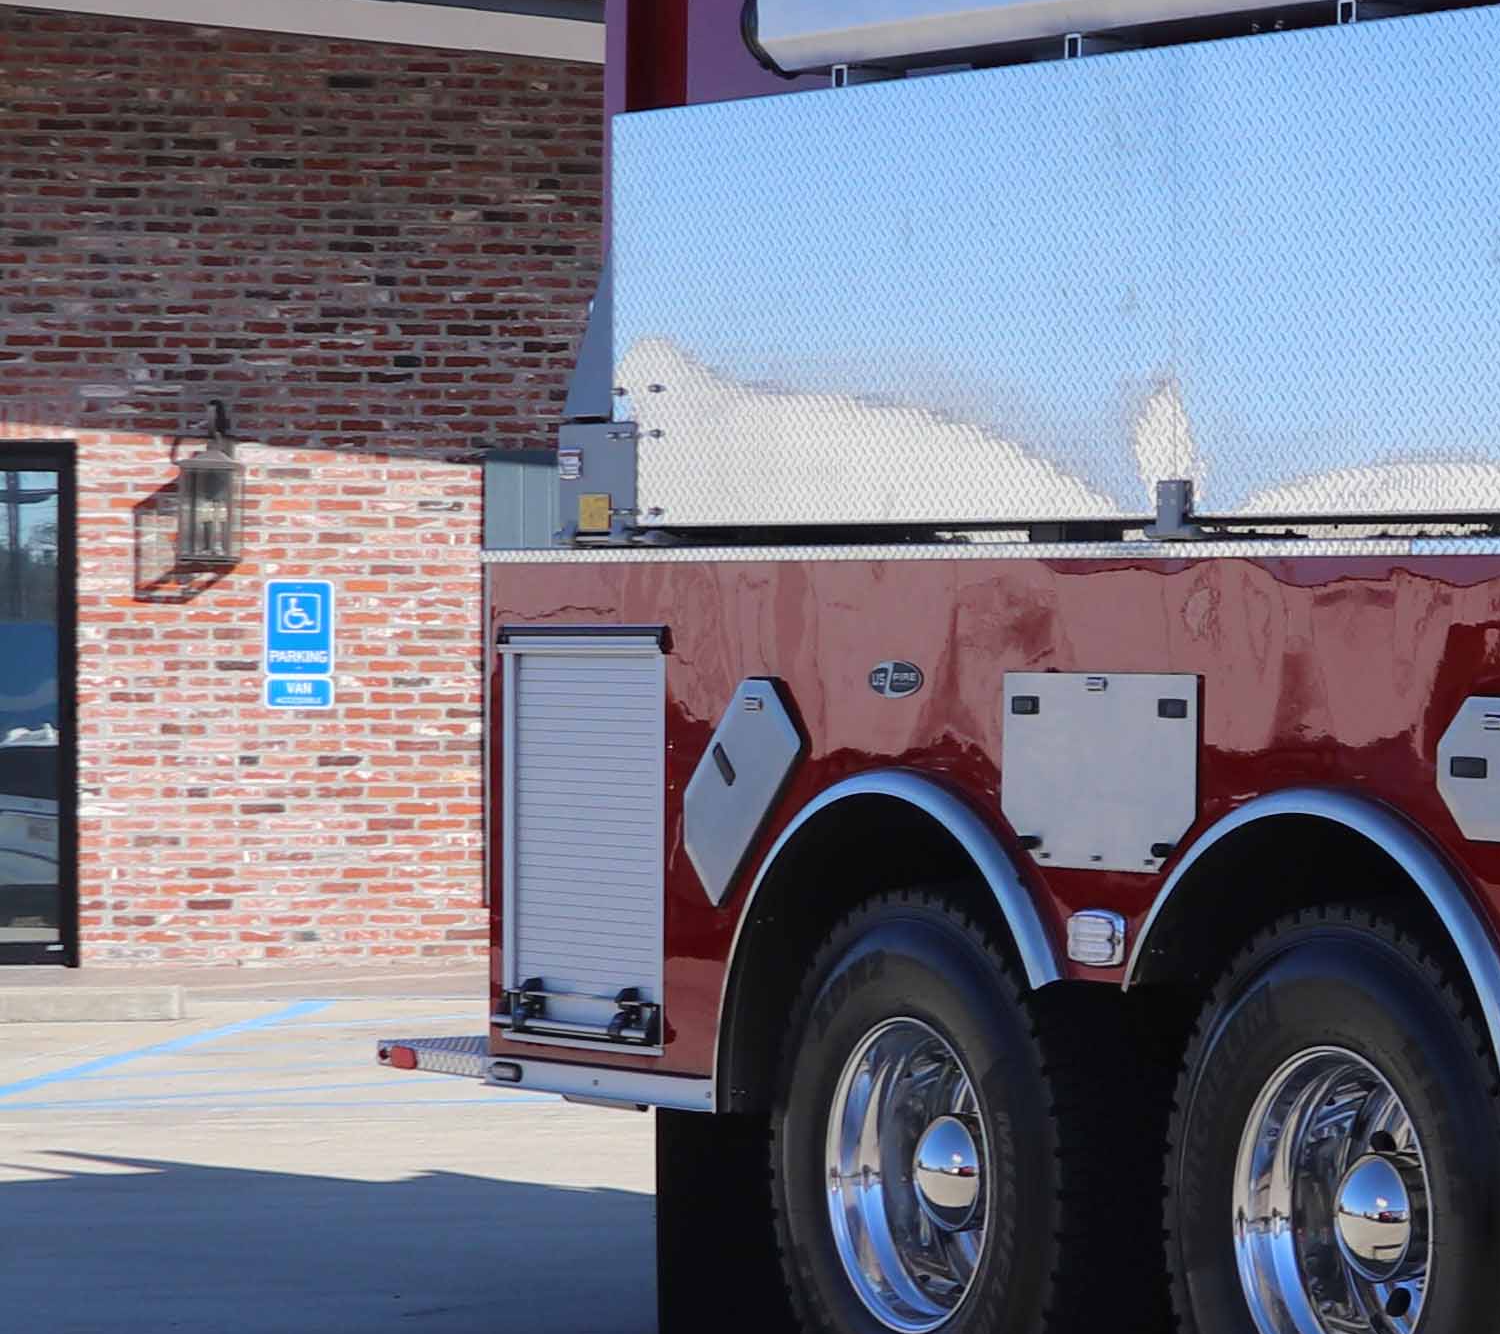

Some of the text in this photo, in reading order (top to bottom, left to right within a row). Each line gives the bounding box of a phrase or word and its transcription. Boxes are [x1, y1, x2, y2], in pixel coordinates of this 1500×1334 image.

[269, 650, 328, 663] PARKING
[872, 672, 917, 685] US FIRE
[286, 682, 312, 694] VAN
